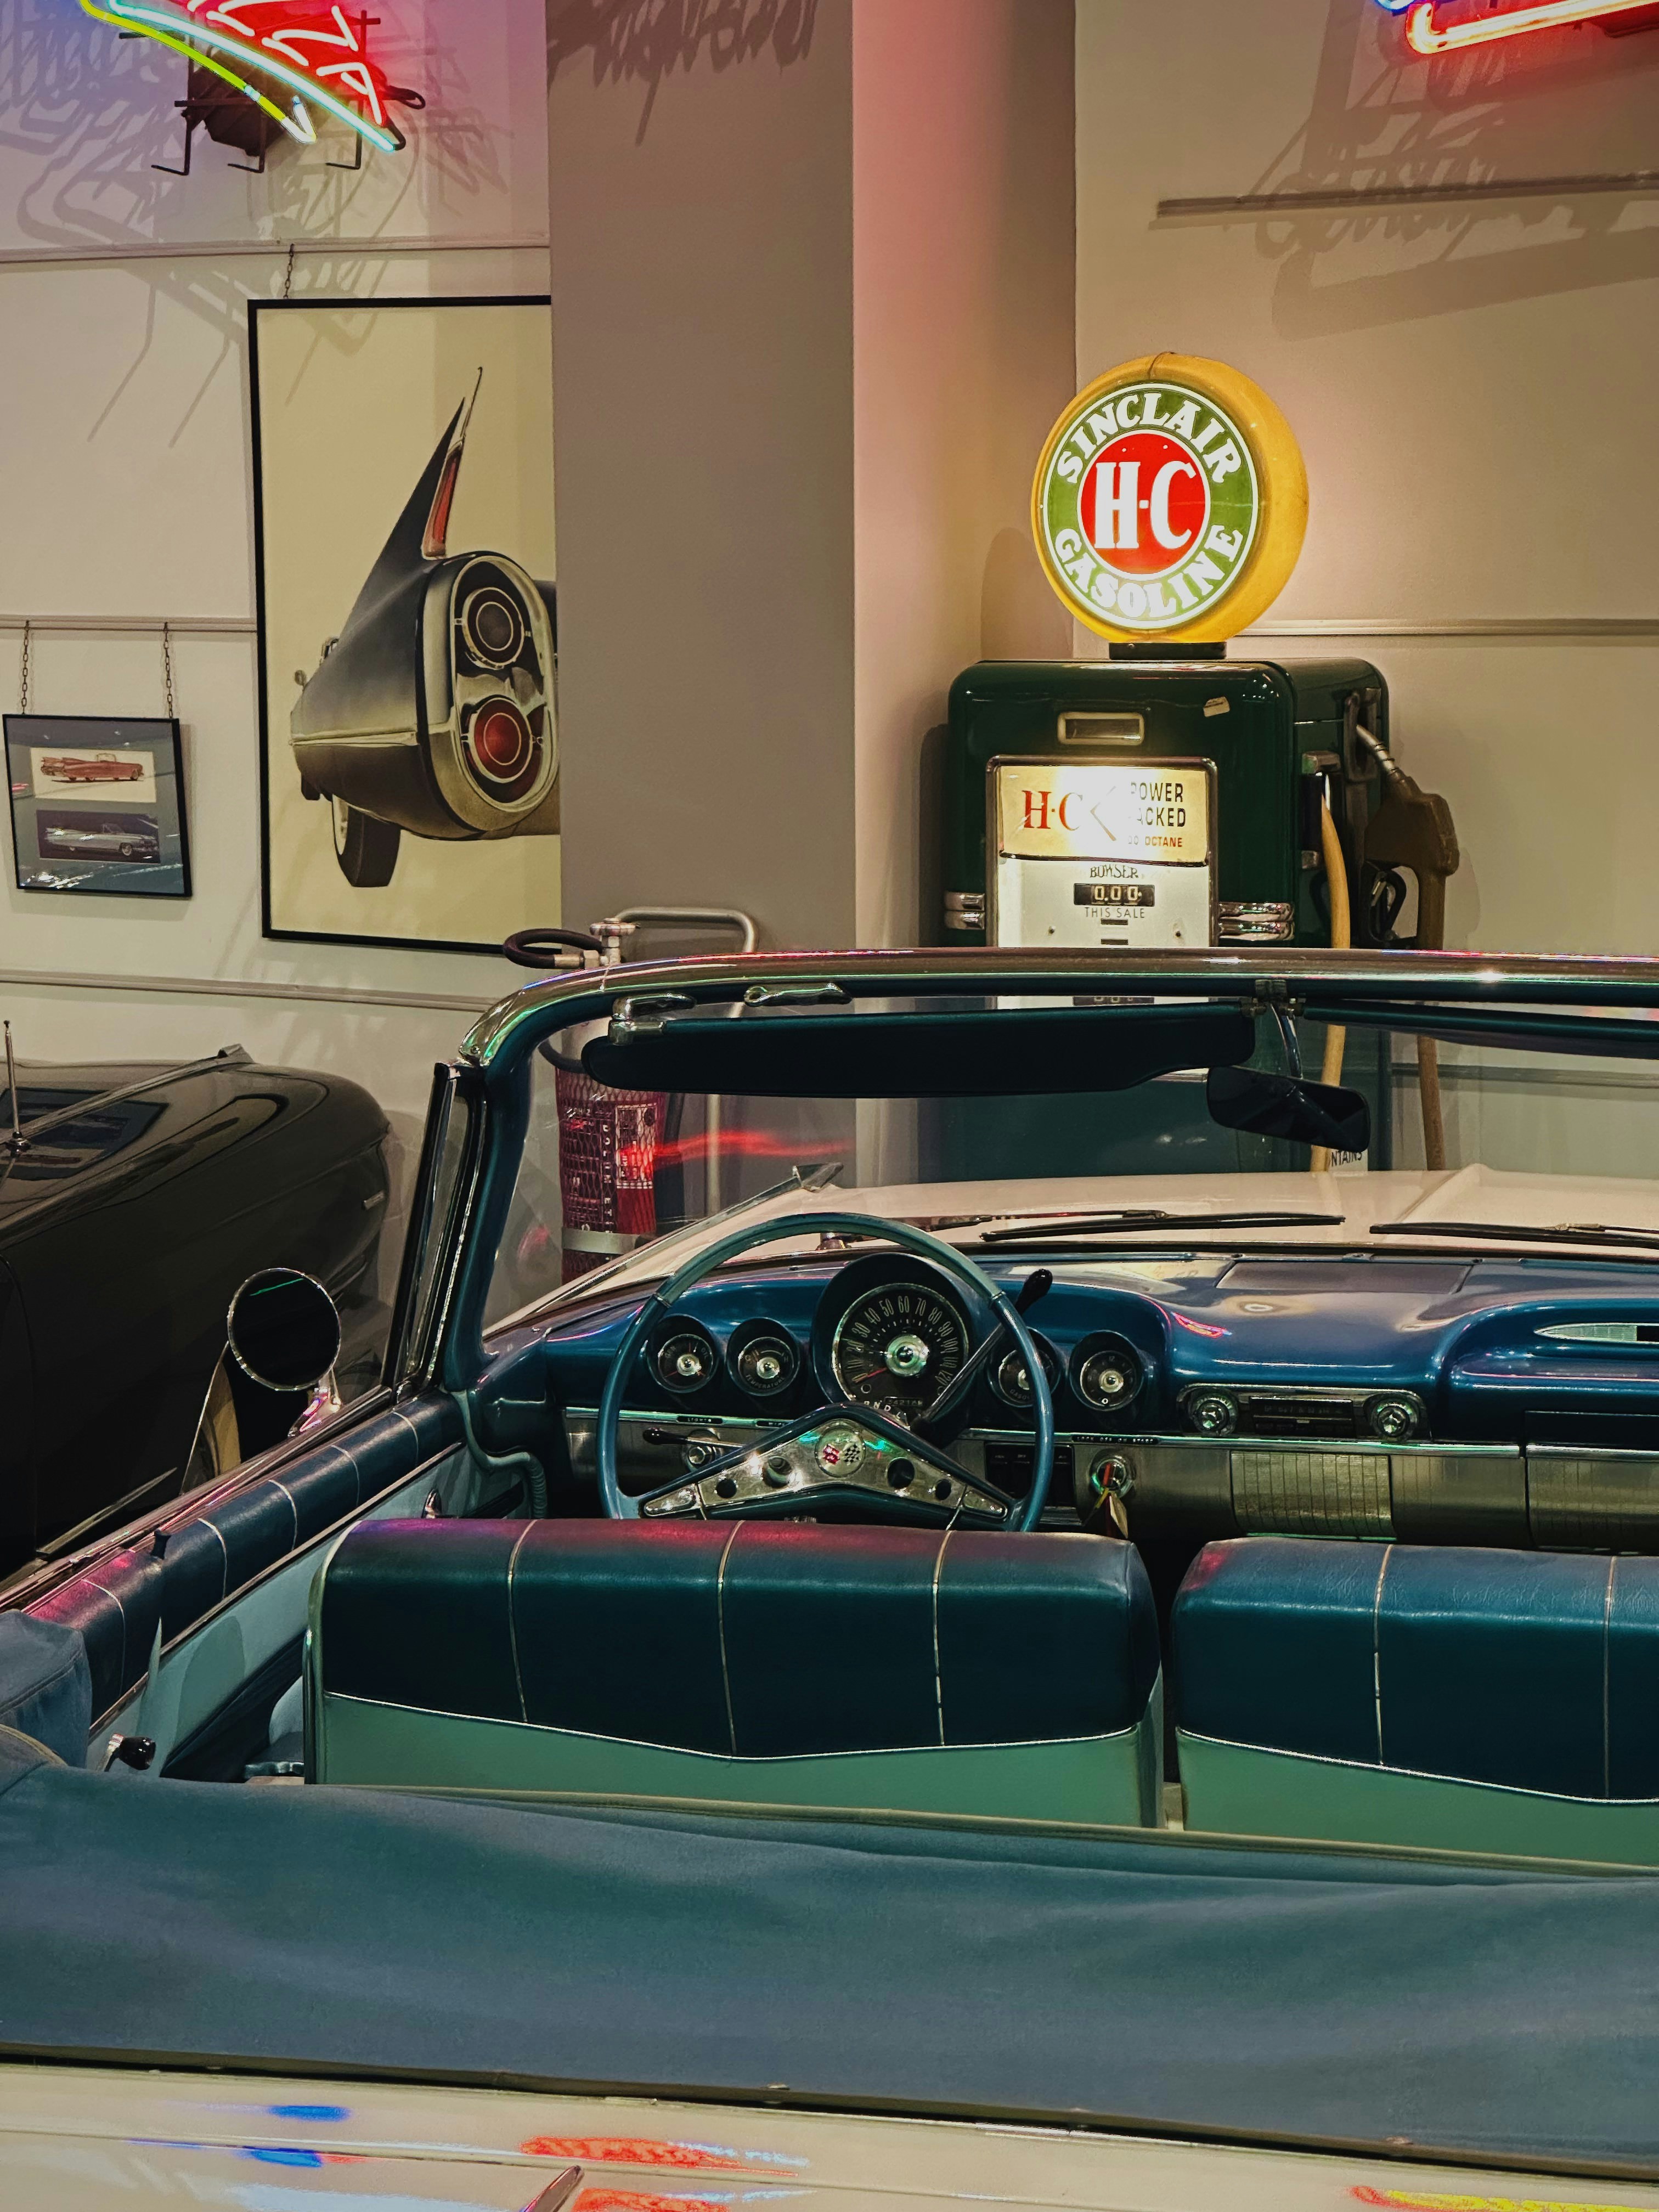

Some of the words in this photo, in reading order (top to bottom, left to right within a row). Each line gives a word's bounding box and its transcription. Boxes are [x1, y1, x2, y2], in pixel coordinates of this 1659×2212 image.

[1057, 392, 1243, 483] SINCLAIR
[1054, 524, 1244, 618] GASOLINE
[1145, 836, 1183, 848] OCTANE
[1090, 864, 1139, 879] BOWSER
[1084, 907, 1111, 918] THIS
[1116, 907, 1146, 918] SALE
[879, 1298, 894, 1317] 50
[898, 1295, 910, 1313] 60
[915, 1297, 927, 1317] 70
[864, 1307, 881, 1324] 40
[928, 1307, 943, 1325] 80
[851, 1322, 871, 1339] 30
[938, 1321, 955, 1338] 90
[846, 1341, 865, 1353] 20
[940, 1337, 960, 1354] 100
